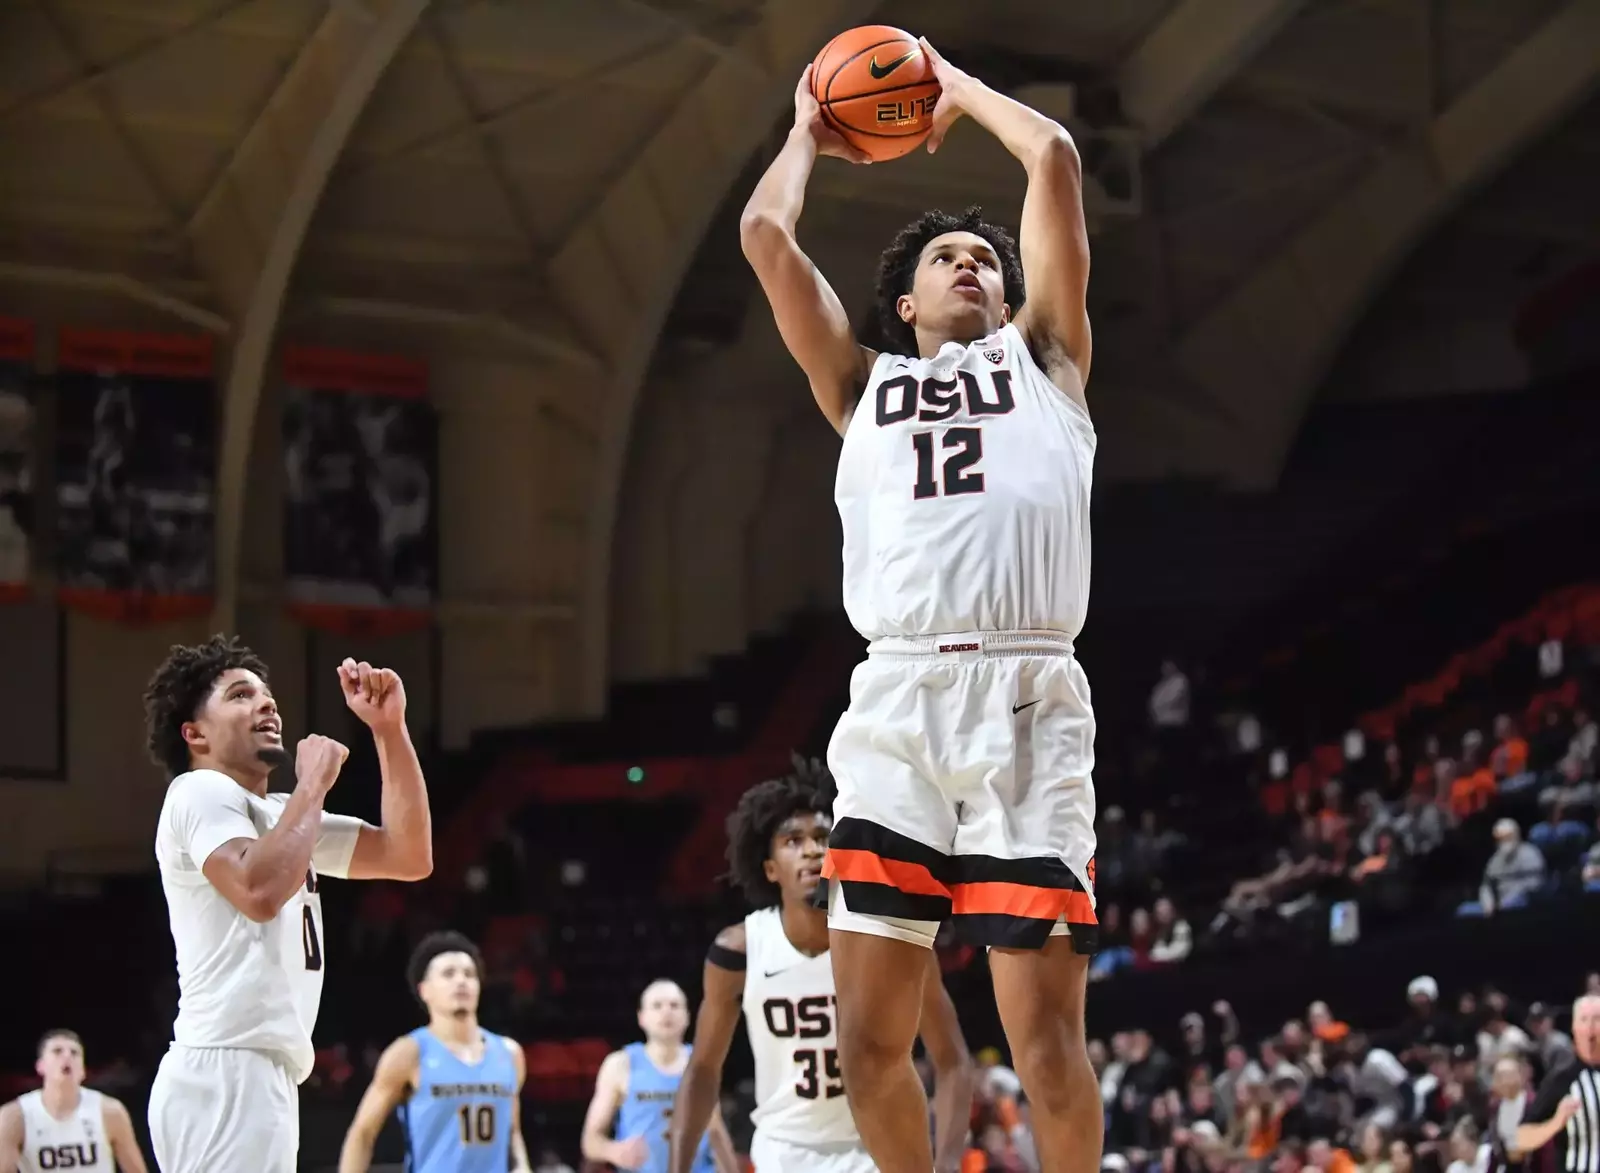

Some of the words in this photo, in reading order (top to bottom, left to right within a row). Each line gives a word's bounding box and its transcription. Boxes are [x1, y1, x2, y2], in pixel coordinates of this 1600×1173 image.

[877, 93, 938, 122] ELITE
[875, 369, 1015, 427] OSU
[912, 427, 985, 500] 12
[938, 643, 979, 653] BEAVERS
[763, 995, 837, 1039] OS
[457, 1103, 496, 1143] 10
[38, 1143, 98, 1170] OSU
